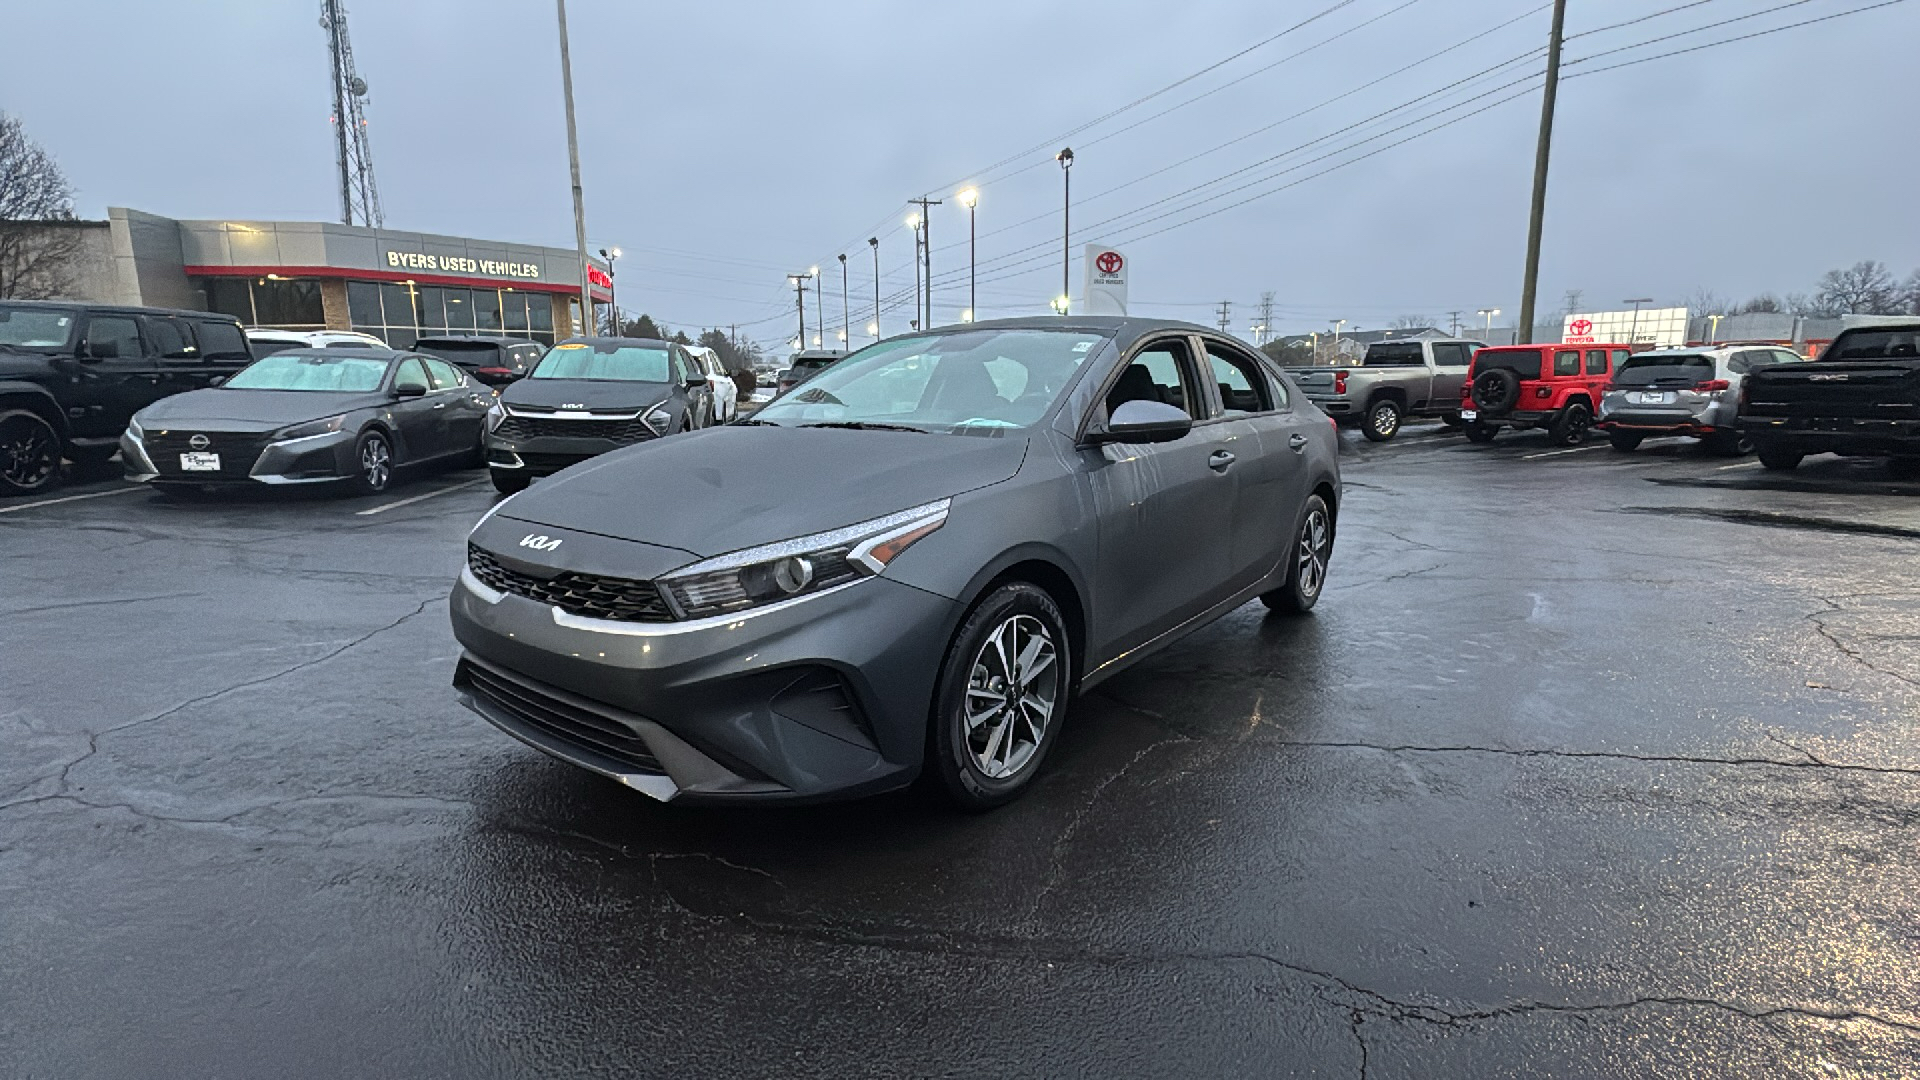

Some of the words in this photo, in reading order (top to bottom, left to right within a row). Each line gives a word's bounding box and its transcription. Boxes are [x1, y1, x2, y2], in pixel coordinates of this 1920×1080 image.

[387, 251, 437, 269] BYERS
[439, 256, 476, 273] USED
[479, 259, 539, 278] VEHICLES
[1565, 336, 1595, 344] TOYOTA
[519, 533, 563, 551] KIA
